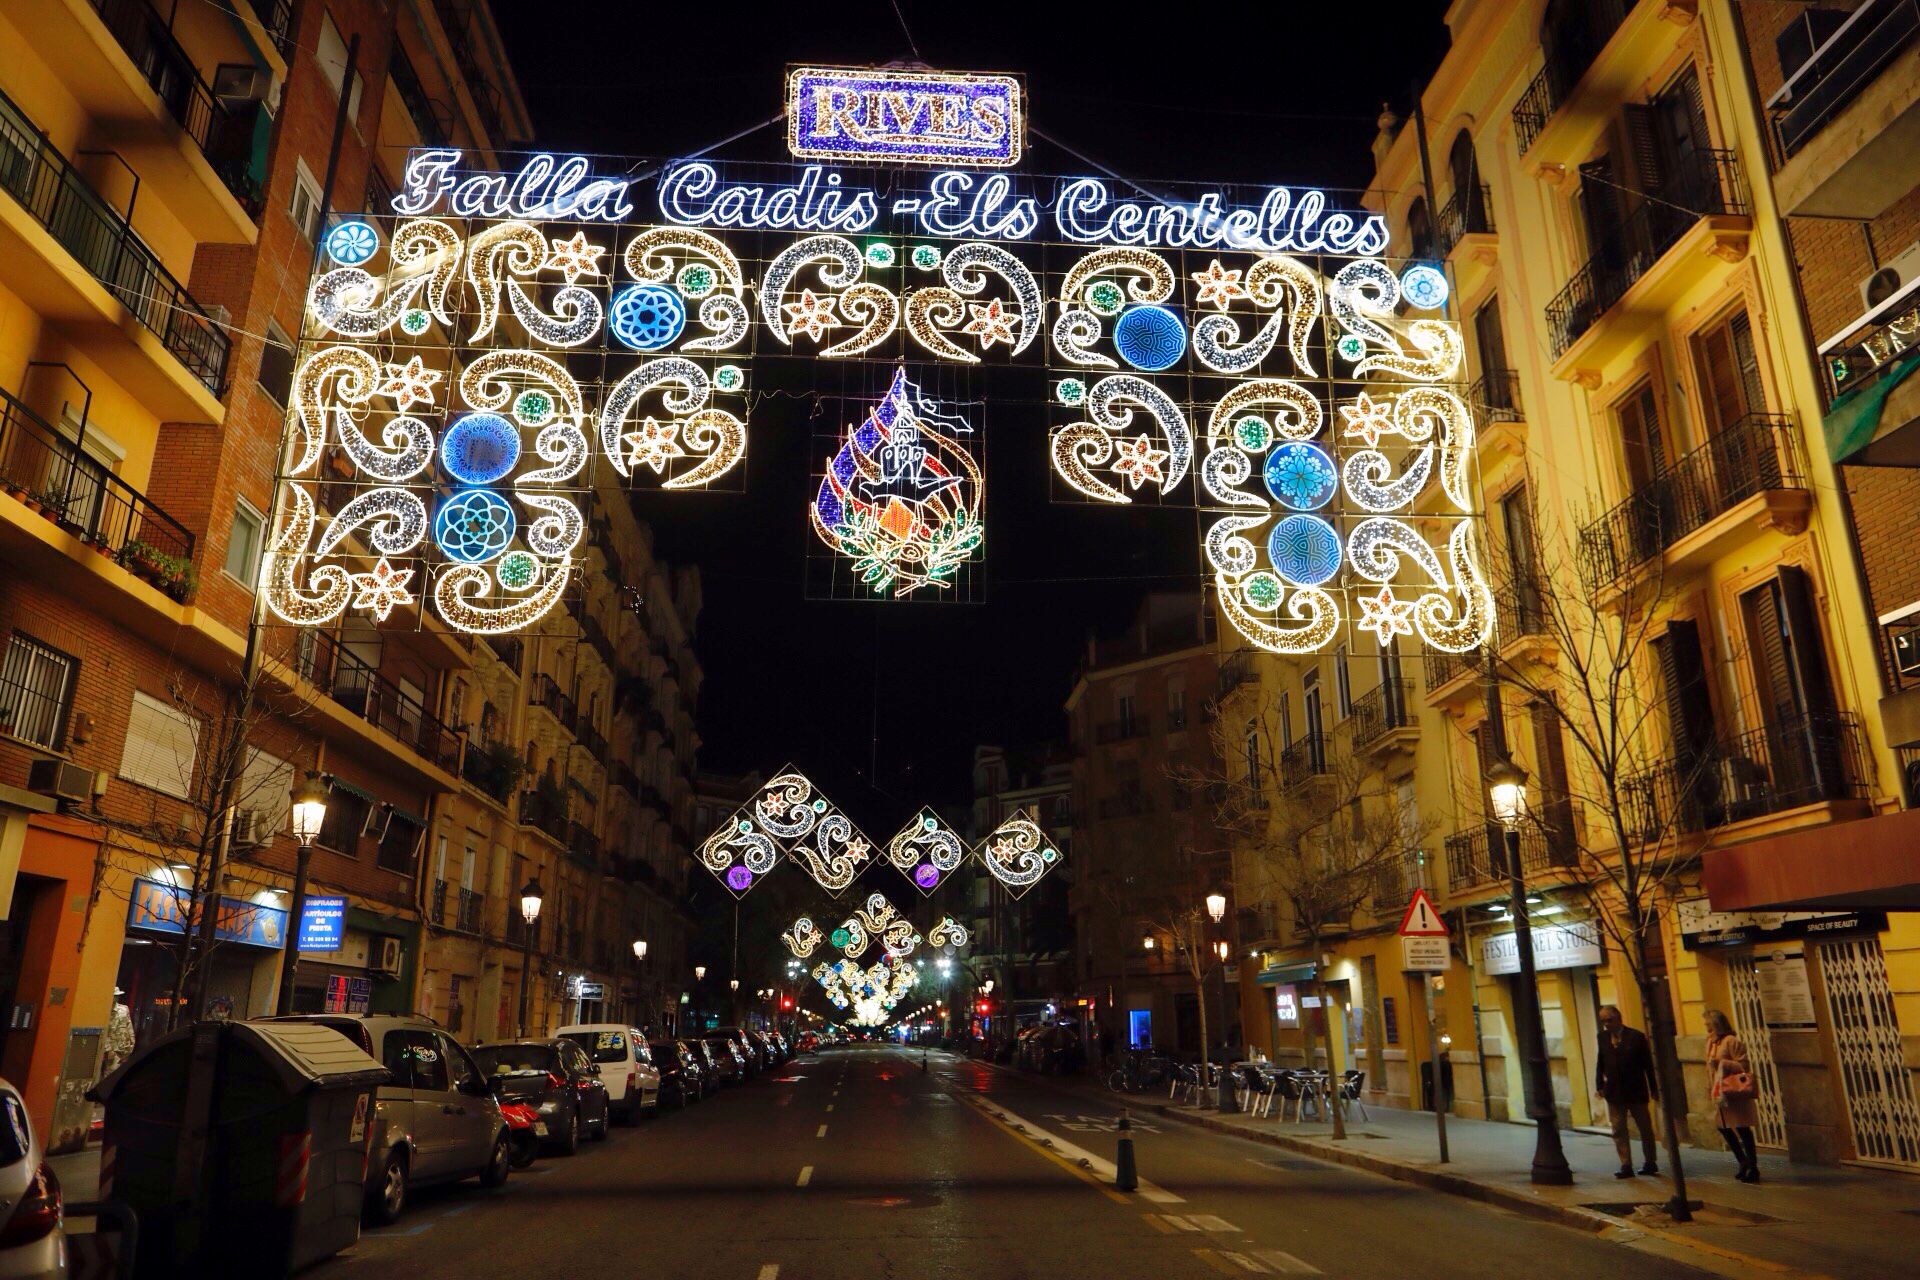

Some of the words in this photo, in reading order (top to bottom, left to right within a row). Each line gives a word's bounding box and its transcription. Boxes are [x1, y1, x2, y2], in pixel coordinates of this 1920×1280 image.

[810, 85, 1007, 143] RIVES
[391, 150, 634, 221] Falla
[659, 162, 879, 232] Cadis
[1055, 178, 1391, 256] Centelles
[1807, 922, 1826, 932] SPACE
[1826, 921, 1835, 929] OF
[1835, 919, 1858, 929] BEAUTY
